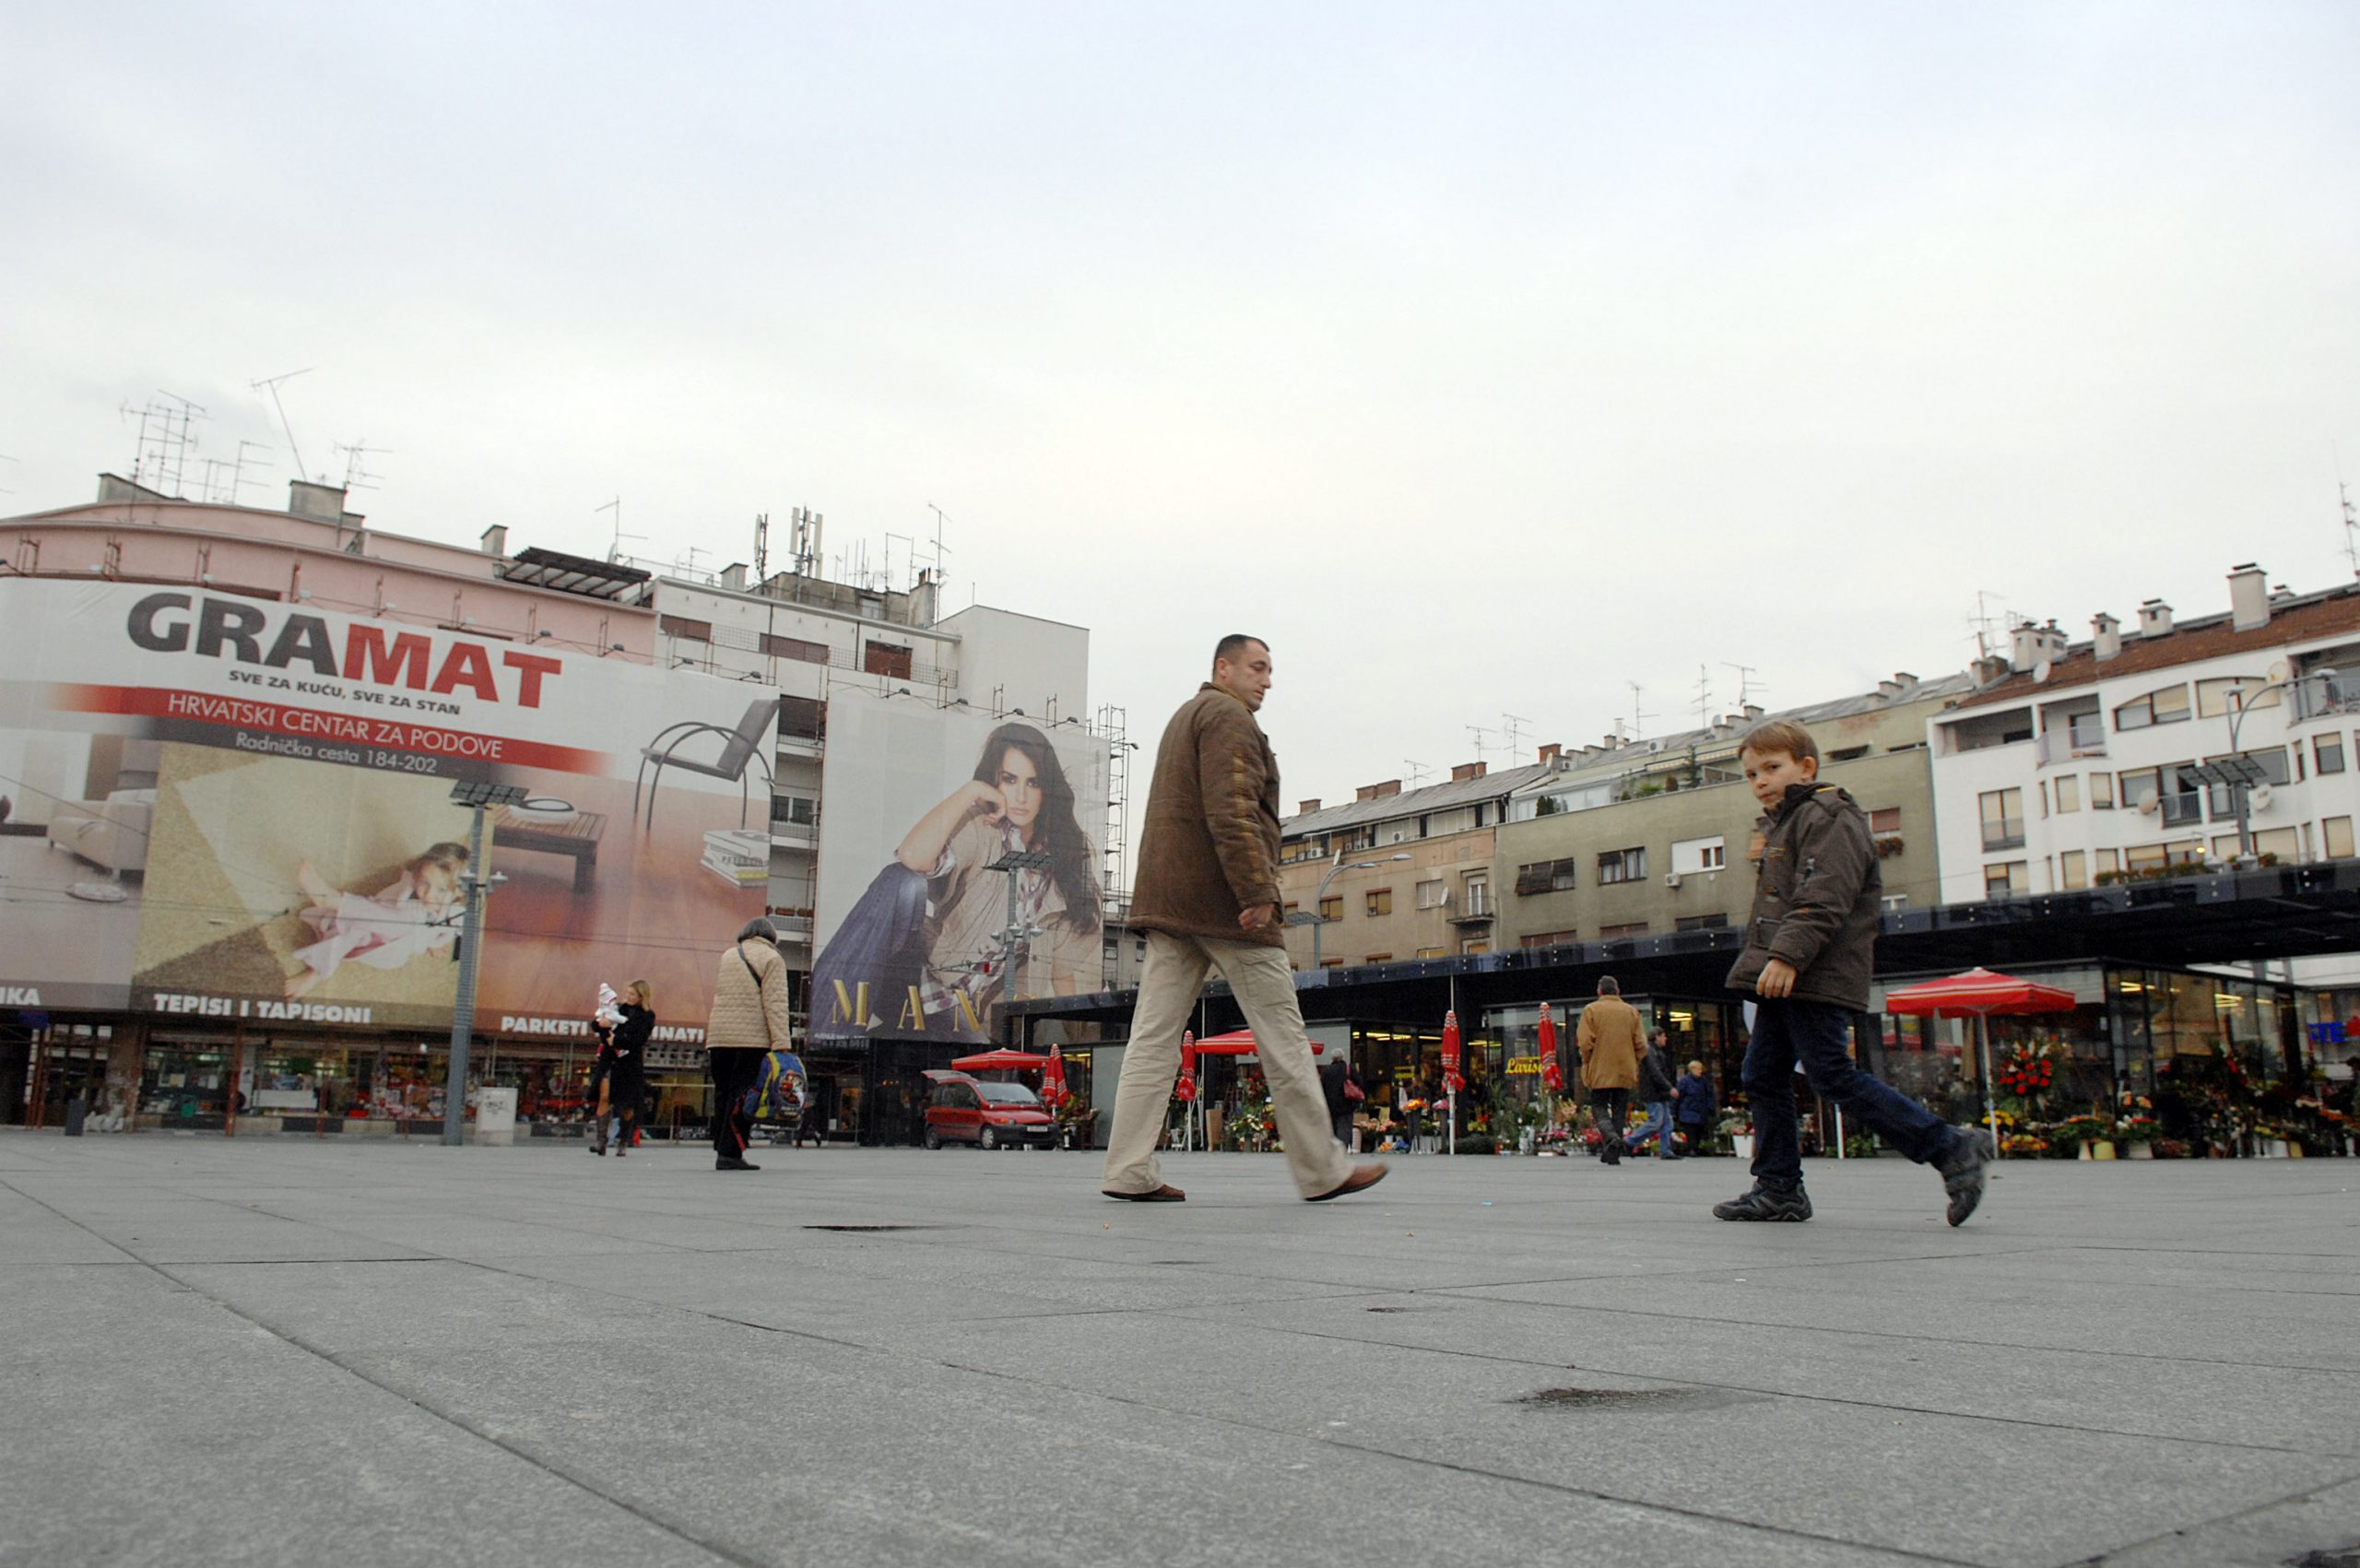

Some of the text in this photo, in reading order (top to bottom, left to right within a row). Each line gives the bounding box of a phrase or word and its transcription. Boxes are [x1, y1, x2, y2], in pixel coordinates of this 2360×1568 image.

[127, 592, 561, 708] GRAMAT
[228, 669, 460, 715] SVE ZA KUĆU, SVE ZA STAN
[169, 694, 502, 759] HRVATSKI CENTAR ZA PODOVE
[236, 732, 438, 773] Radnička cesta 184-202
[153, 993, 372, 1024] TEPISI I TAPISONI
[832, 979, 1035, 1032] MAN
[501, 1015, 705, 1043] PARKETI INATI
